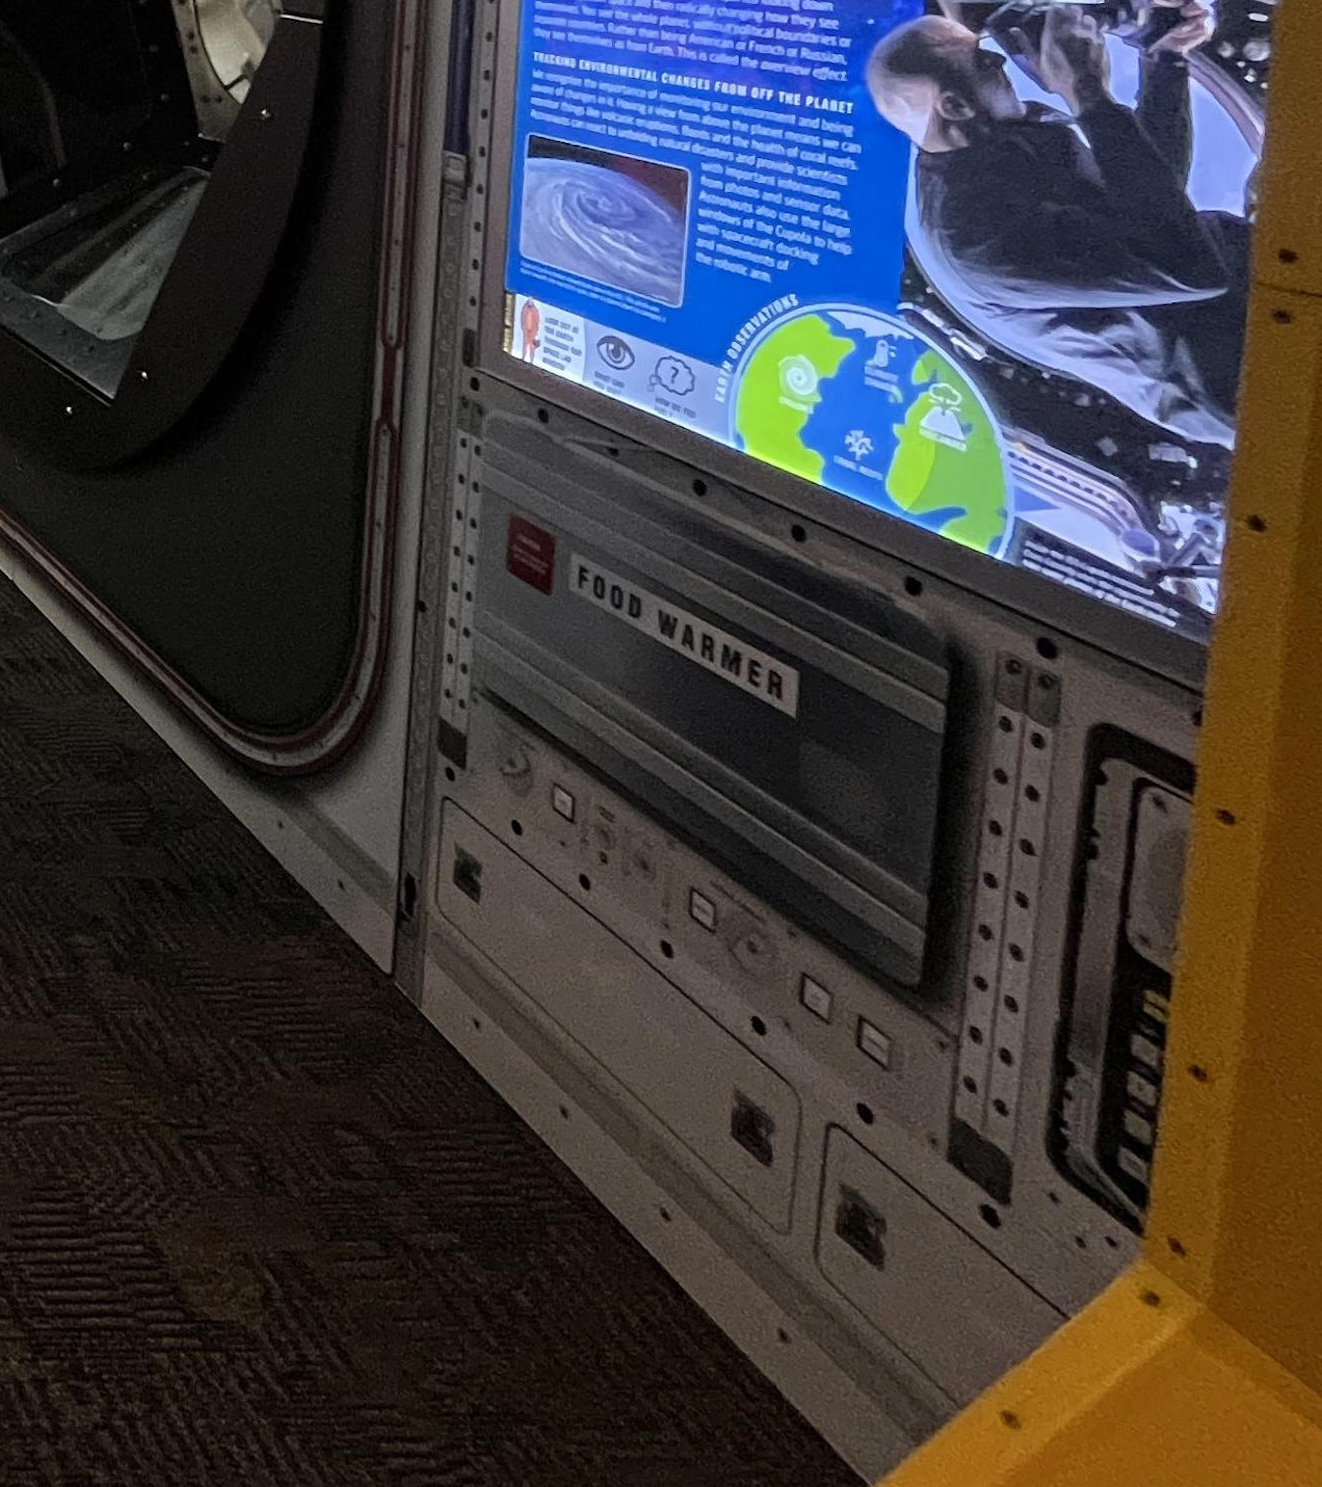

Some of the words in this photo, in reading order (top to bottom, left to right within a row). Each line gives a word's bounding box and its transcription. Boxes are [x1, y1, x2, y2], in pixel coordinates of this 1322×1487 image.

[533, 51, 576, 69] TRACKING
[578, 59, 657, 82] ENVIRONMENTAL
[661, 71, 710, 91] CHANGES
[714, 81, 747, 96] FROM
[750, 87, 774, 101] OFF
[778, 91, 801, 106] THE
[805, 96, 854, 114] PLANET
[714, 360, 734, 403] EARTH
[726, 293, 799, 359] OBSERVATIONS
[578, 565, 642, 619] FOOD
[658, 609, 782, 700] WARMER
